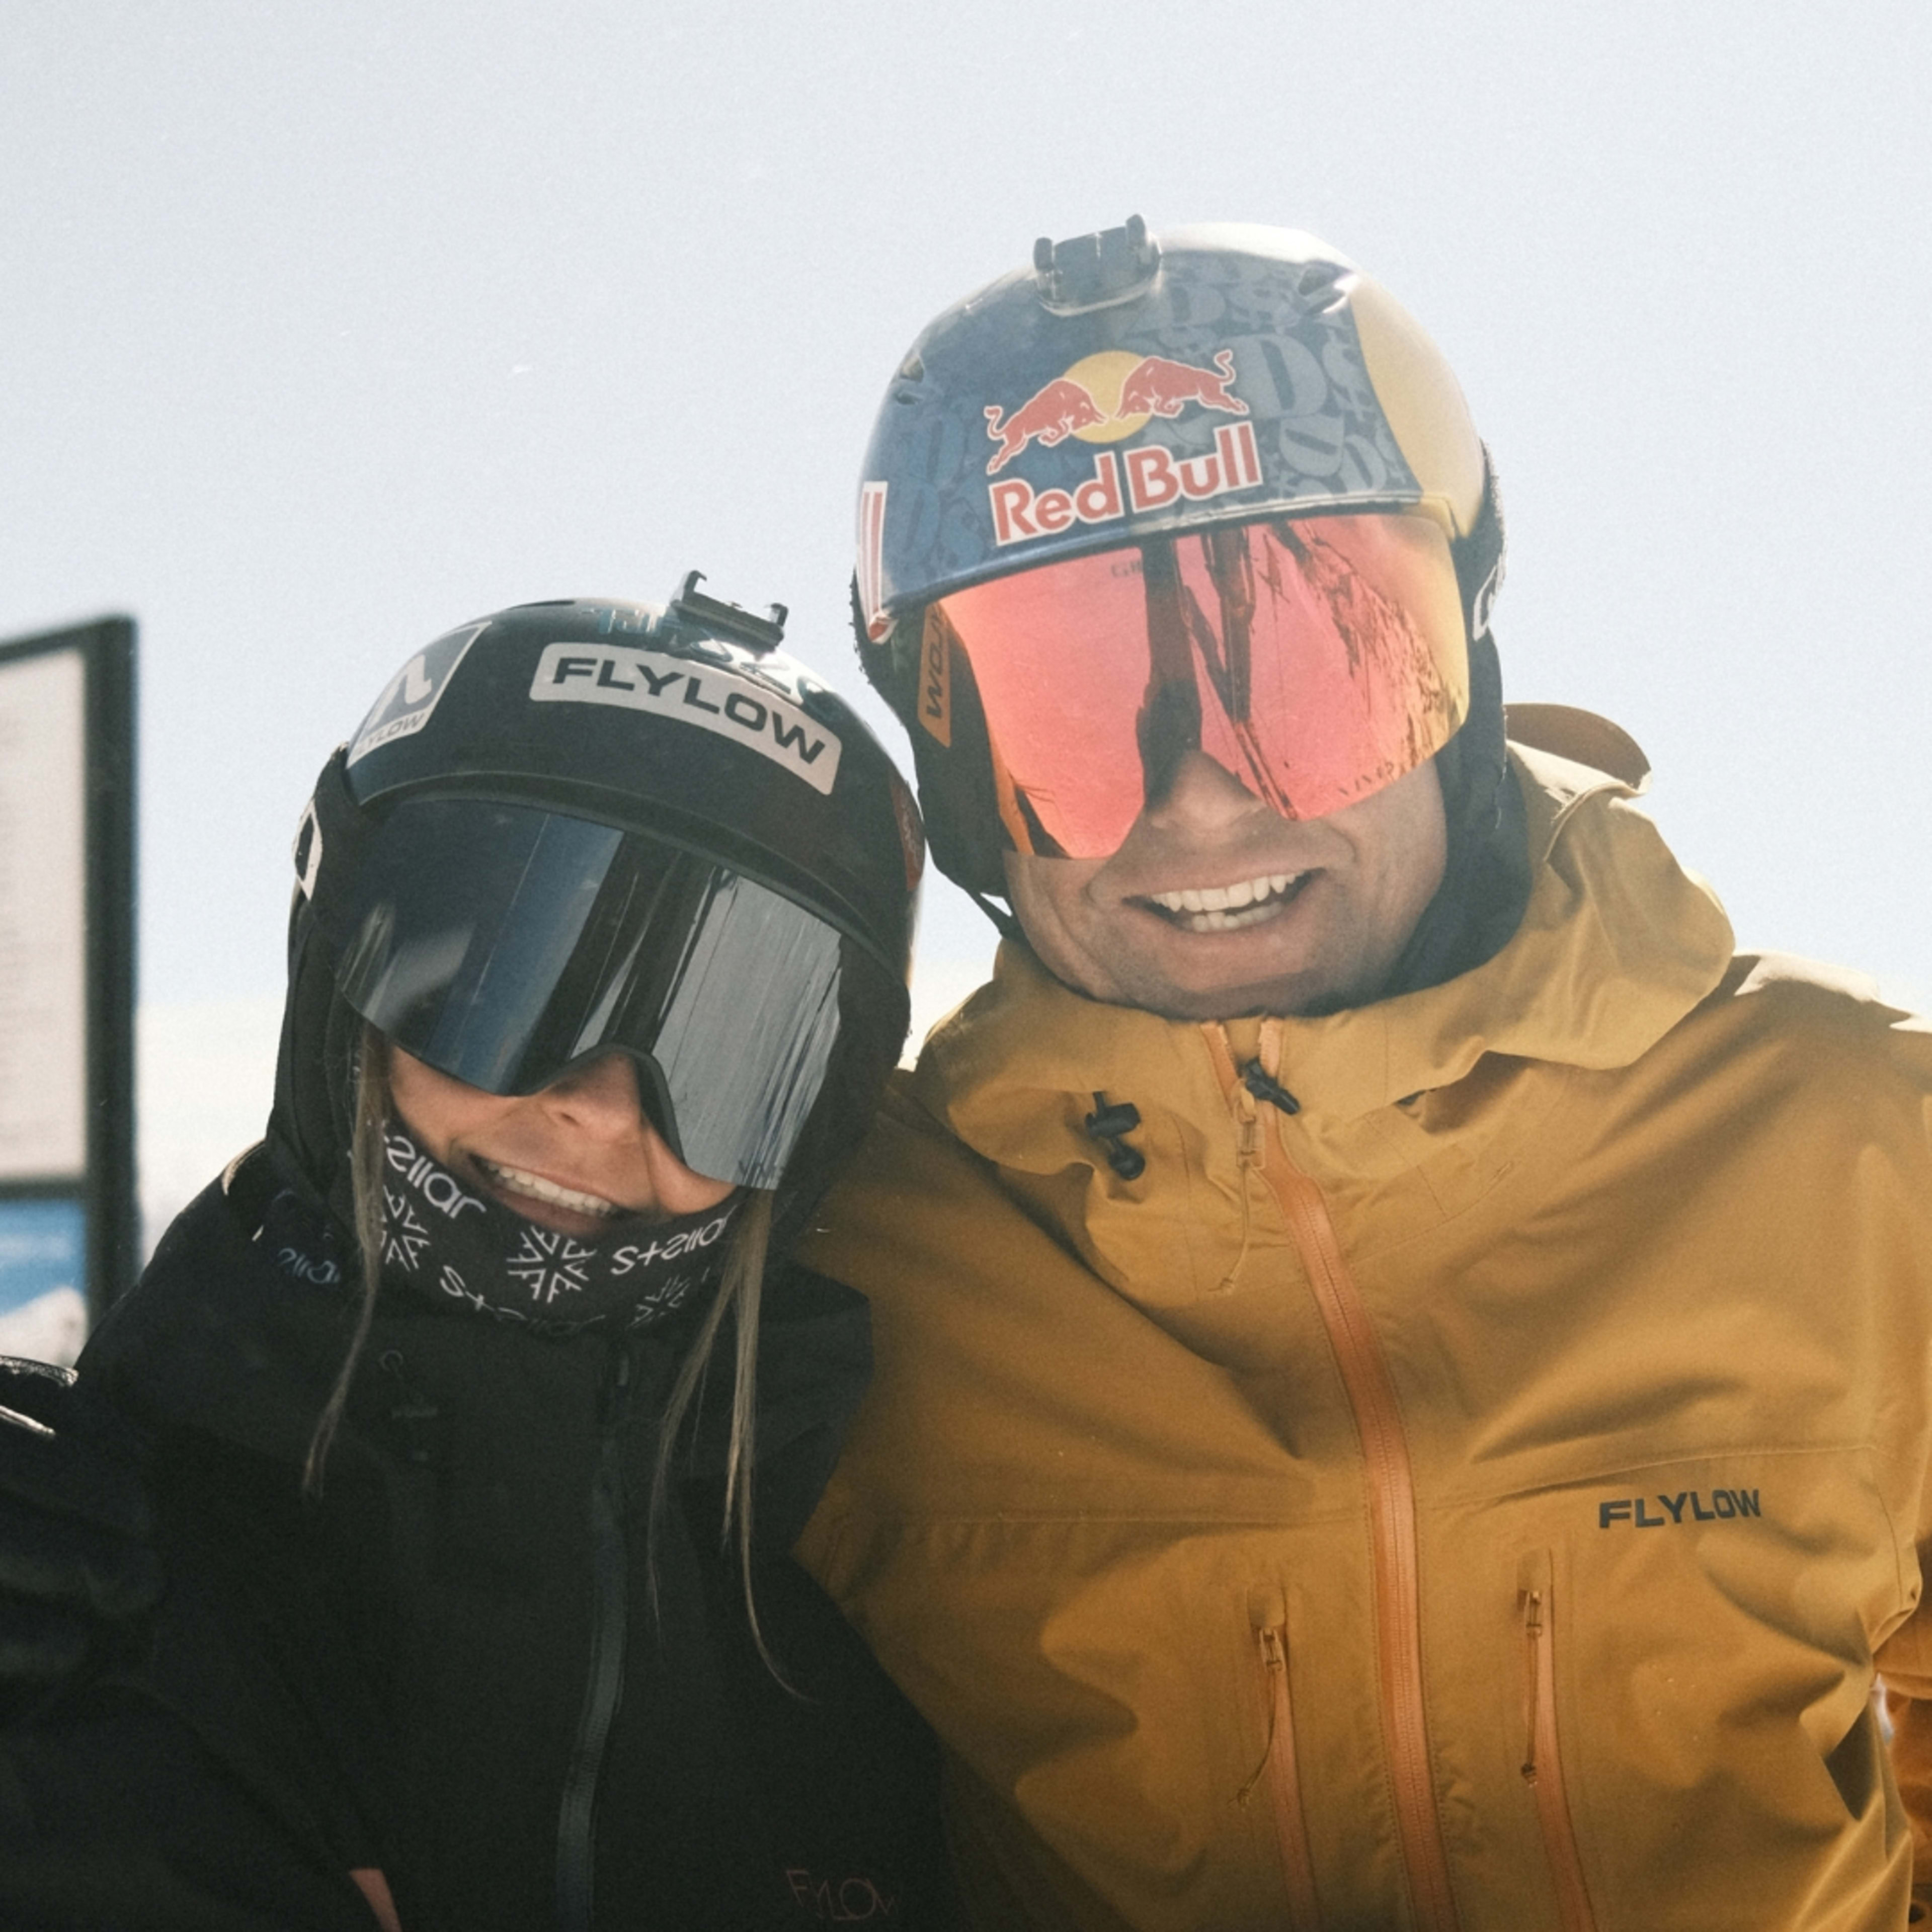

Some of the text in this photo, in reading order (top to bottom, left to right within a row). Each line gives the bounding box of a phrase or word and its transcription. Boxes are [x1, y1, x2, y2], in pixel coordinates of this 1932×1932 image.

[989, 422, 1262, 545] Red Bull
[552, 657, 827, 765] FLYLOW
[1598, 1489, 1761, 1528] FLYLOW
